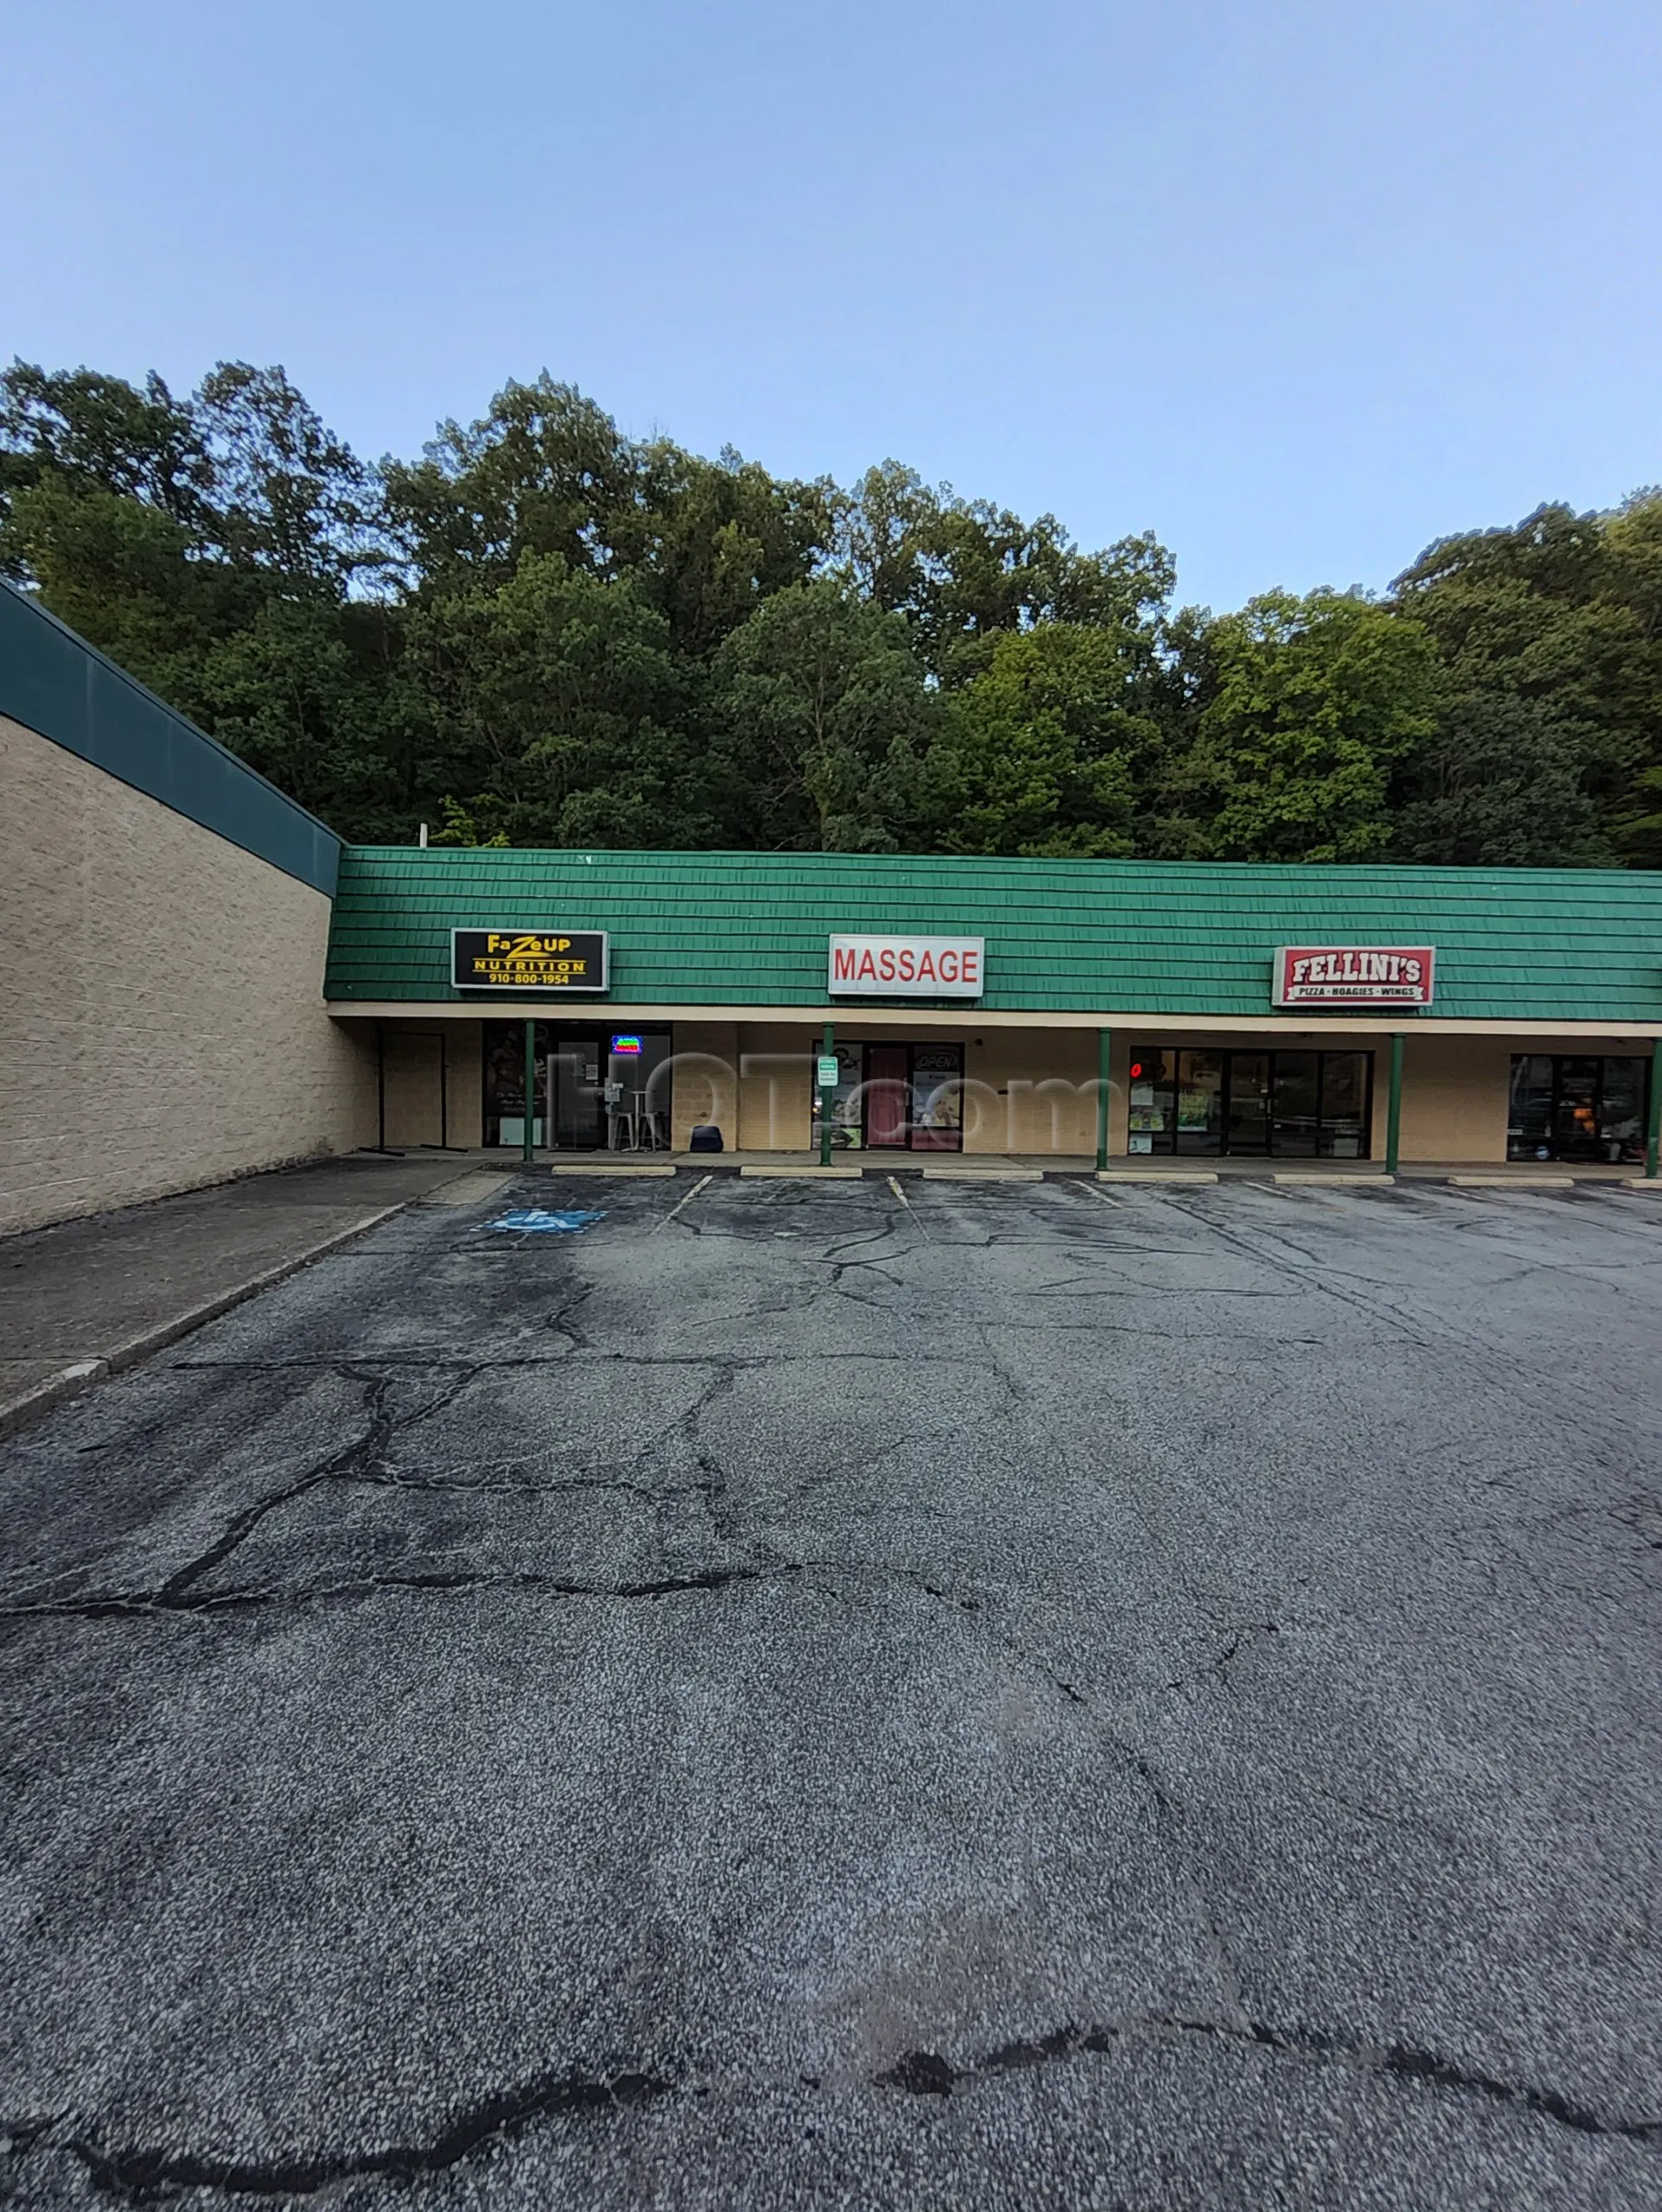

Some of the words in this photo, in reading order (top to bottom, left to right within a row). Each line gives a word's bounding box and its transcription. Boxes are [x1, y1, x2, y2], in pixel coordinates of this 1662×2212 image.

[474, 961, 584, 971] NUTRITION
[834, 949, 977, 983] MASSAGE
[1292, 952, 1421, 982] FELLINI'S
[489, 973, 570, 984] 910-800-1954
[919, 1055, 952, 1069] OPEN
